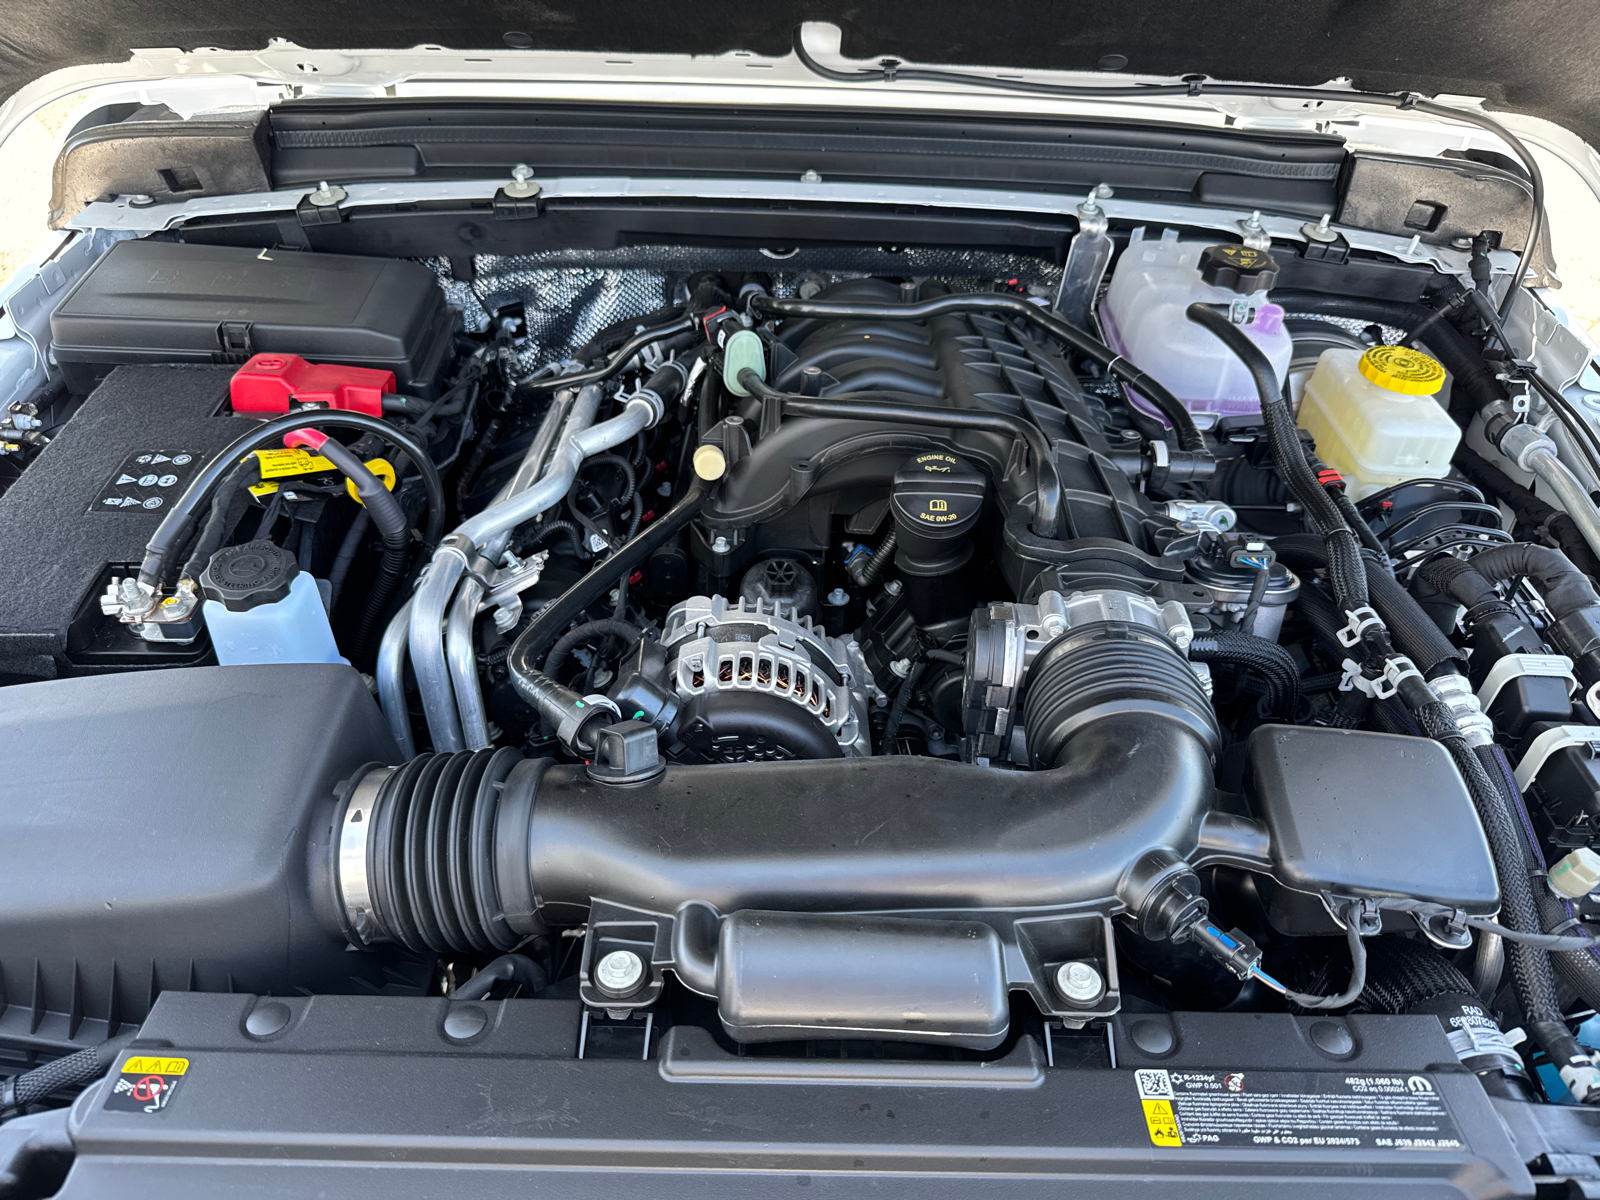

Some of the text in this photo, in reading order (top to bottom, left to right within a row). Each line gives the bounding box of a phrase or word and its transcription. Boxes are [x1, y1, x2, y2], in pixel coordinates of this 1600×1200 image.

[916, 455, 957, 464] ENGINE OIL
[920, 512, 957, 522] SAE 0W-20
[1461, 1005, 1484, 1016] RAD
[1202, 1134, 1220, 1142] PAG
[1281, 1136, 1299, 1144] CO2
[1313, 1137, 1325, 1145] EU
